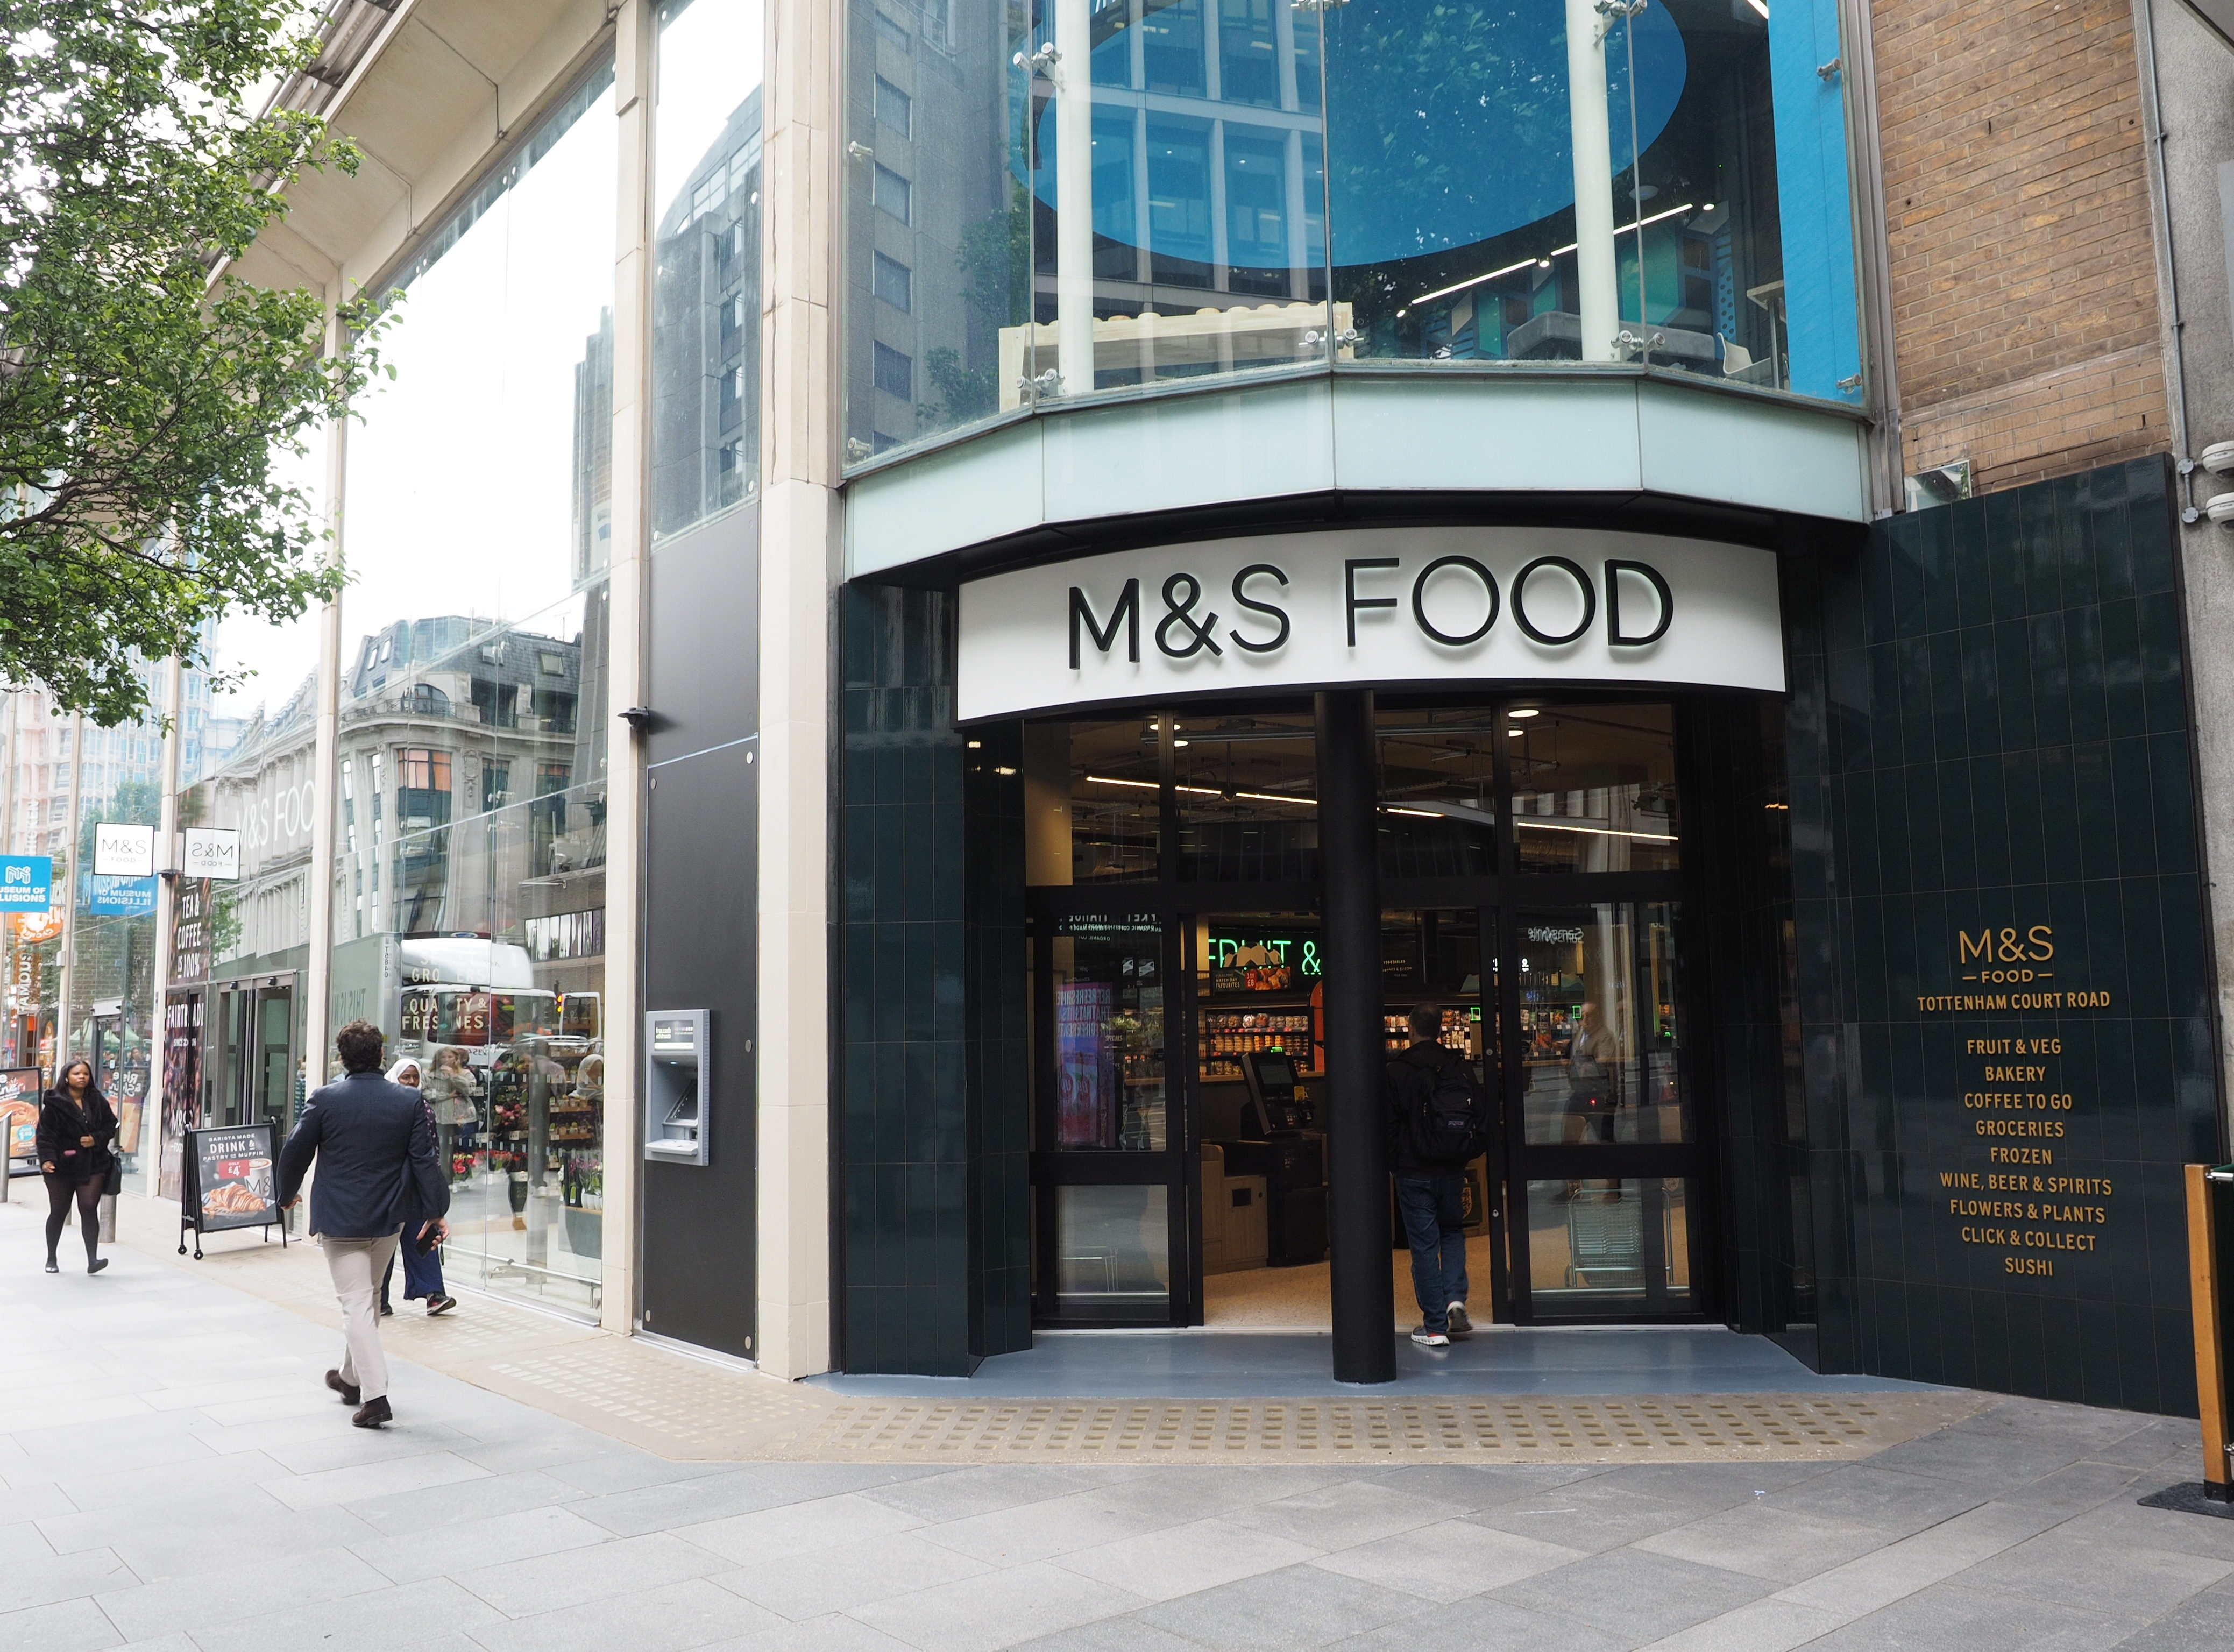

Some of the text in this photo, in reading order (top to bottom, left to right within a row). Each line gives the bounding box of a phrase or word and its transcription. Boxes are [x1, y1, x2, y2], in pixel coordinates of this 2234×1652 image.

[1069, 555, 1674, 670] M&S FOOD
[102, 839, 146, 855] M&S
[182, 892, 200, 920] TEA &
[177, 921, 202, 951] COFFEE
[1959, 925, 2054, 965] M&S
[178, 952, 200, 978] IS 100%
[1302, 941, 1321, 975] &
[412, 968, 485, 982] GROERS
[1247, 979, 1254, 987] £8
[1981, 969, 2034, 983] FOOD
[409, 998, 487, 1014] QUATY &
[1917, 991, 2111, 1012] TOTTENHAM COURT ROAD
[1967, 1038, 2061, 1055] FRUIT & VEG
[1985, 1066, 2046, 1082] BAKERY
[1964, 1093, 2072, 1110] COFFEE TO GO
[1976, 1119, 2065, 1138] GROCERIES
[210, 1141, 246, 1154] DRINK
[1990, 1147, 2053, 1165] FROZEN
[1940, 1172, 2112, 1196] WINE, BEER & SPIRITS
[1950, 1199, 2107, 1224] FLOWERS & PLANTS
[1962, 1226, 2096, 1251] CLICK & COLLECT
[2005, 1257, 2054, 1277] SUSHI
